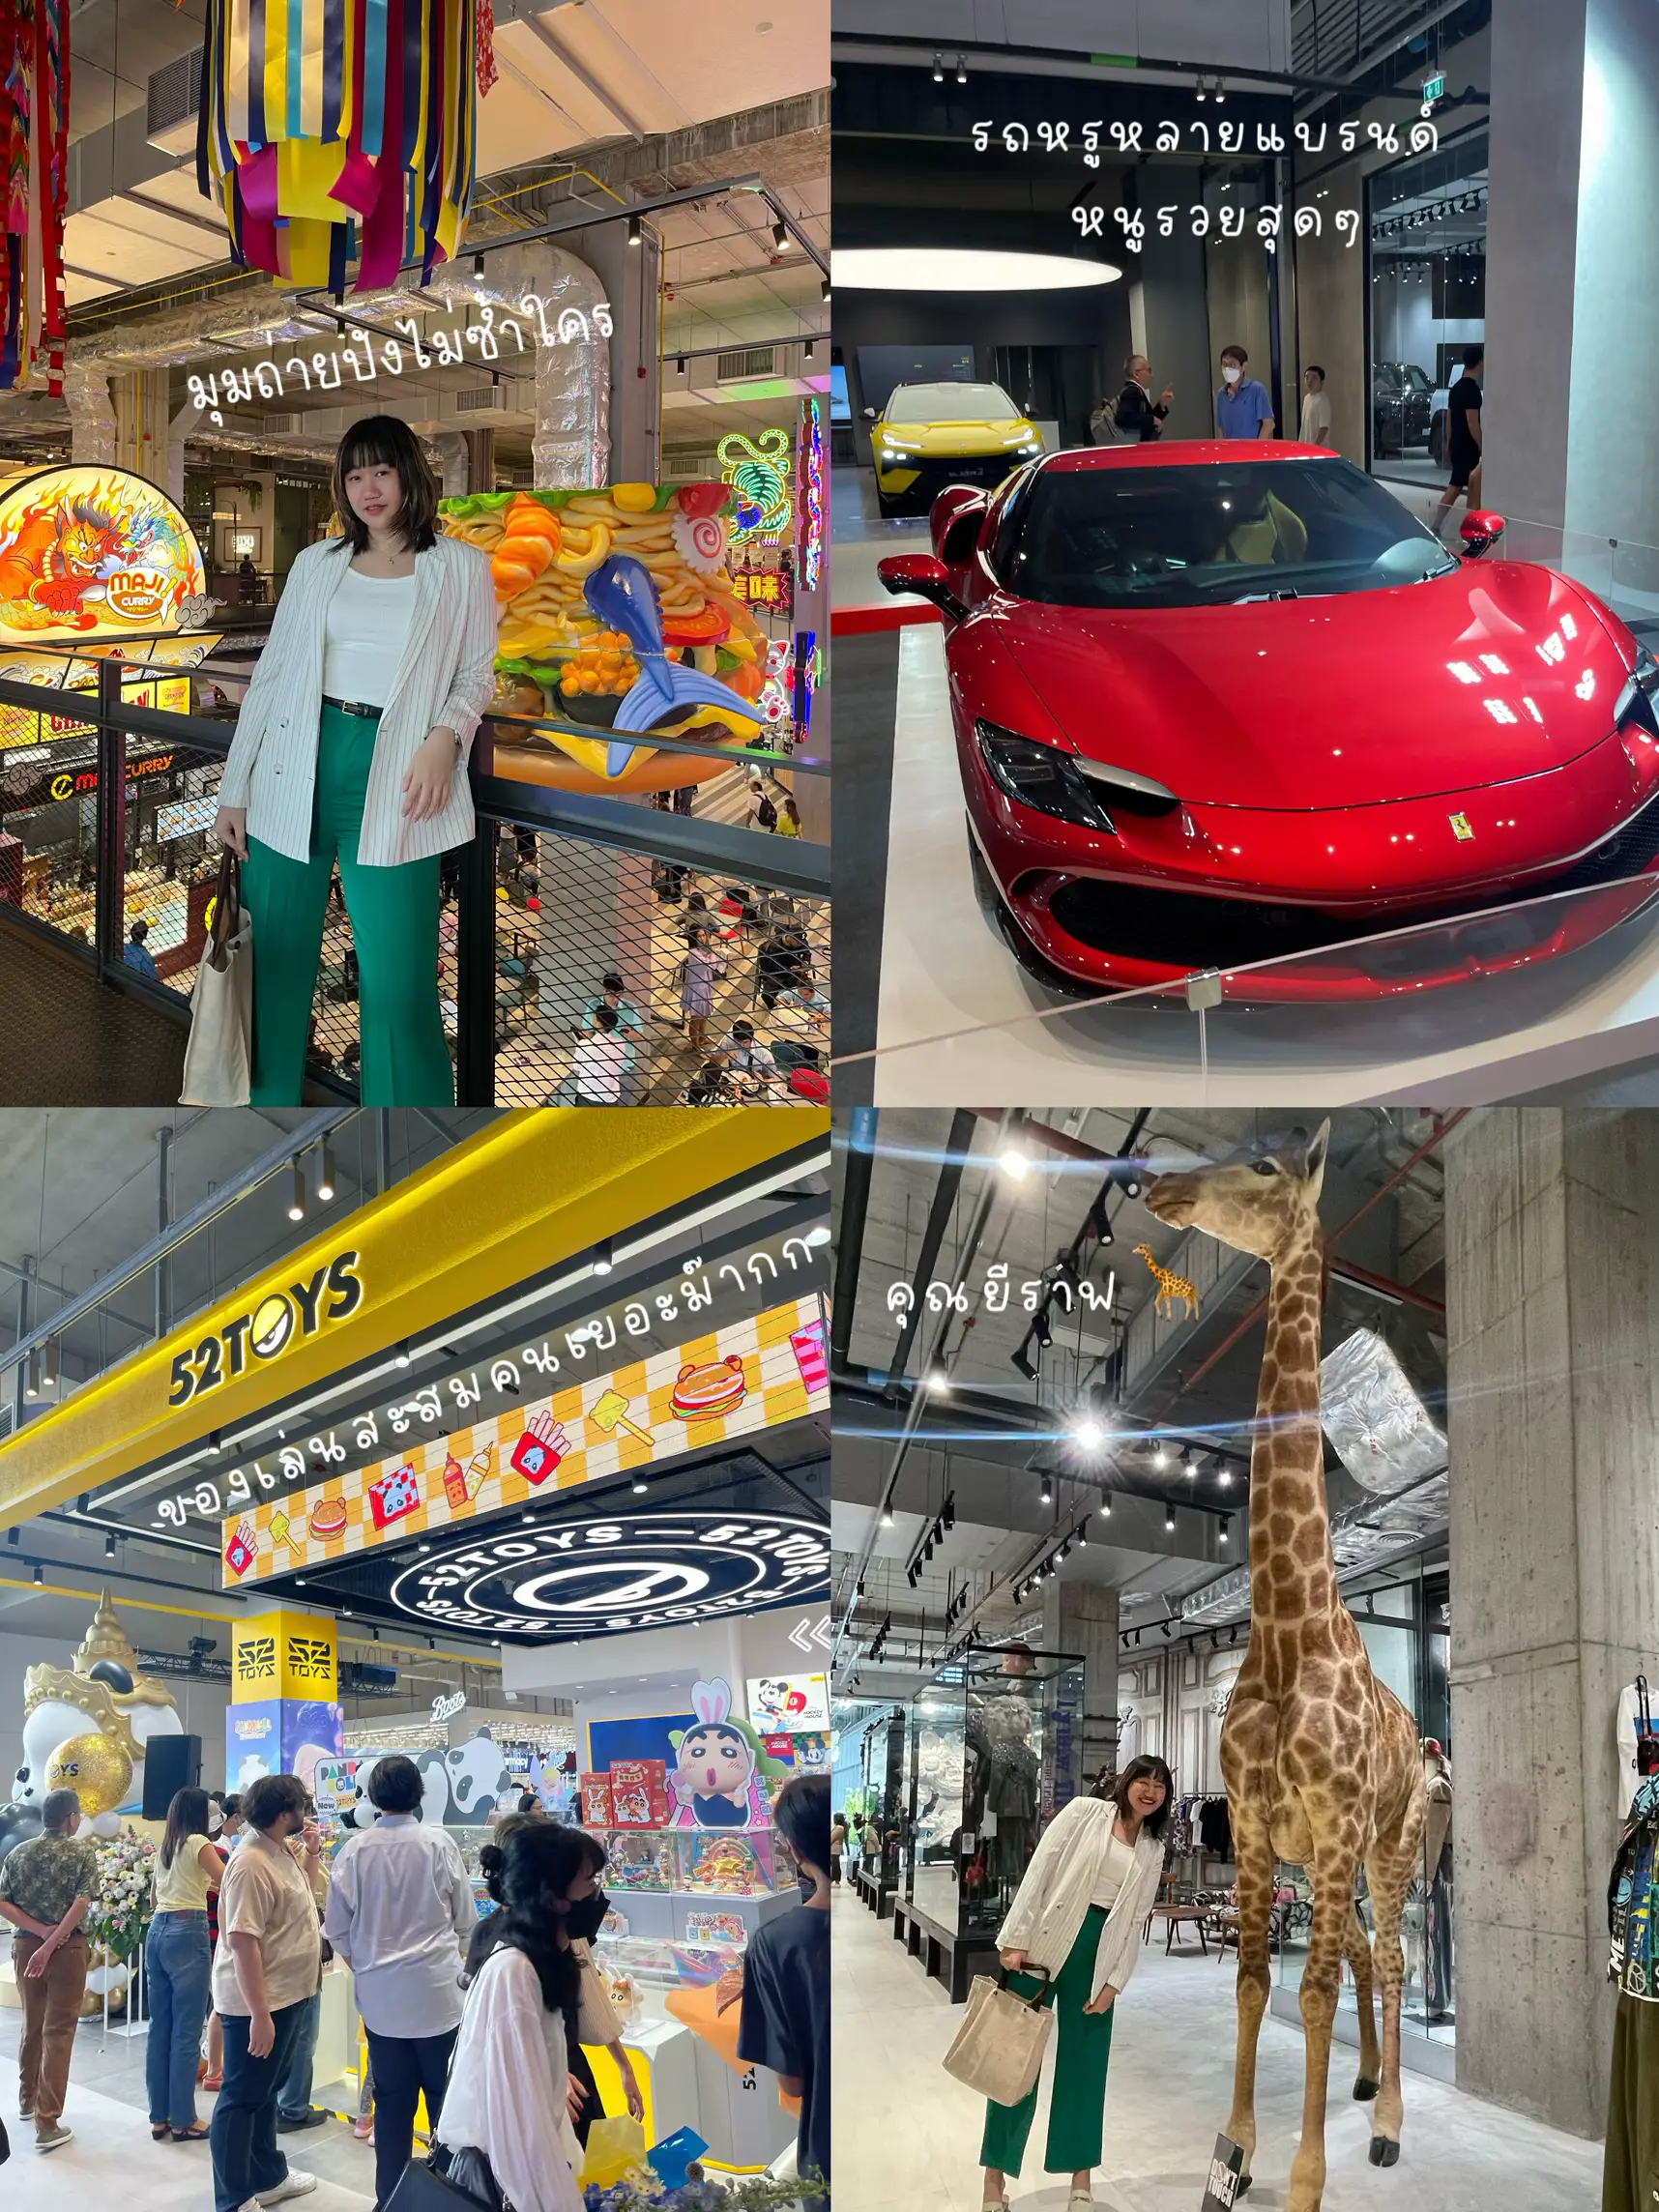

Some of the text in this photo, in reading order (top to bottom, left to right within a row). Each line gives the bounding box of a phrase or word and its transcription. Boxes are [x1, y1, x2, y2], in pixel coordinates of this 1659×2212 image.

[122, 596, 155, 606] CURRY
[168, 1250, 361, 1408] 52TOYS
[418, 1526, 624, 1586] 52TOYS
[699, 1525, 830, 1577] 52TOYS
[238, 1663, 275, 1680] TOYS
[288, 1663, 331, 1679] TOYS
[430, 1691, 467, 1722] Boots
[1208, 2174, 1234, 2208] TOUCH
